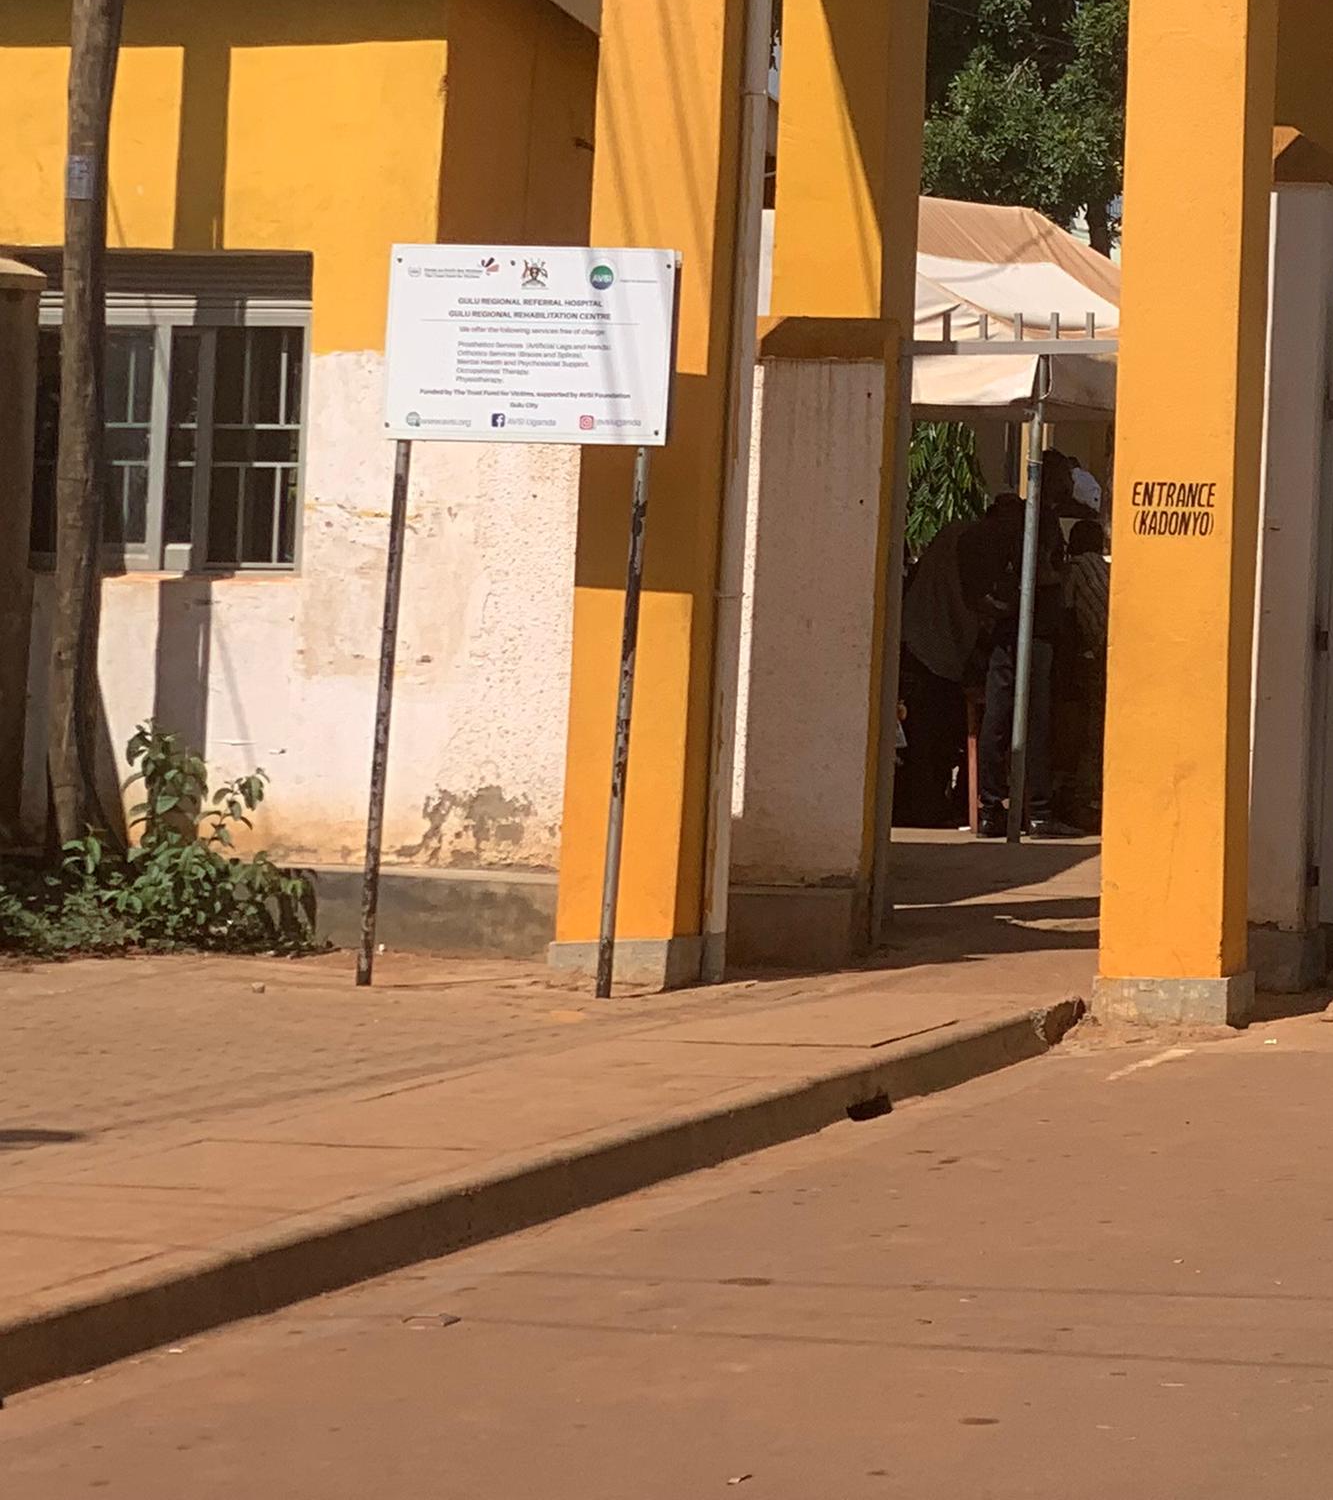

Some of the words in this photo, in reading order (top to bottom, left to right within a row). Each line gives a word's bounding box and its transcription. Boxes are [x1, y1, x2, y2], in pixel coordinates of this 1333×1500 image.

[458, 297, 480, 305] GULU
[481, 297, 522, 306] REGIONAL
[523, 298, 563, 307] REFERRAL
[565, 299, 603, 308] HOSPITAL
[449, 309, 471, 317] GULU
[472, 310, 512, 318] REGIONAL
[513, 311, 578, 320] REHABILITATION
[579, 312, 611, 320] CENTRE
[1132, 481, 1217, 508] ENTRANCE
[1133, 510, 1214, 536] (KADONYO)
